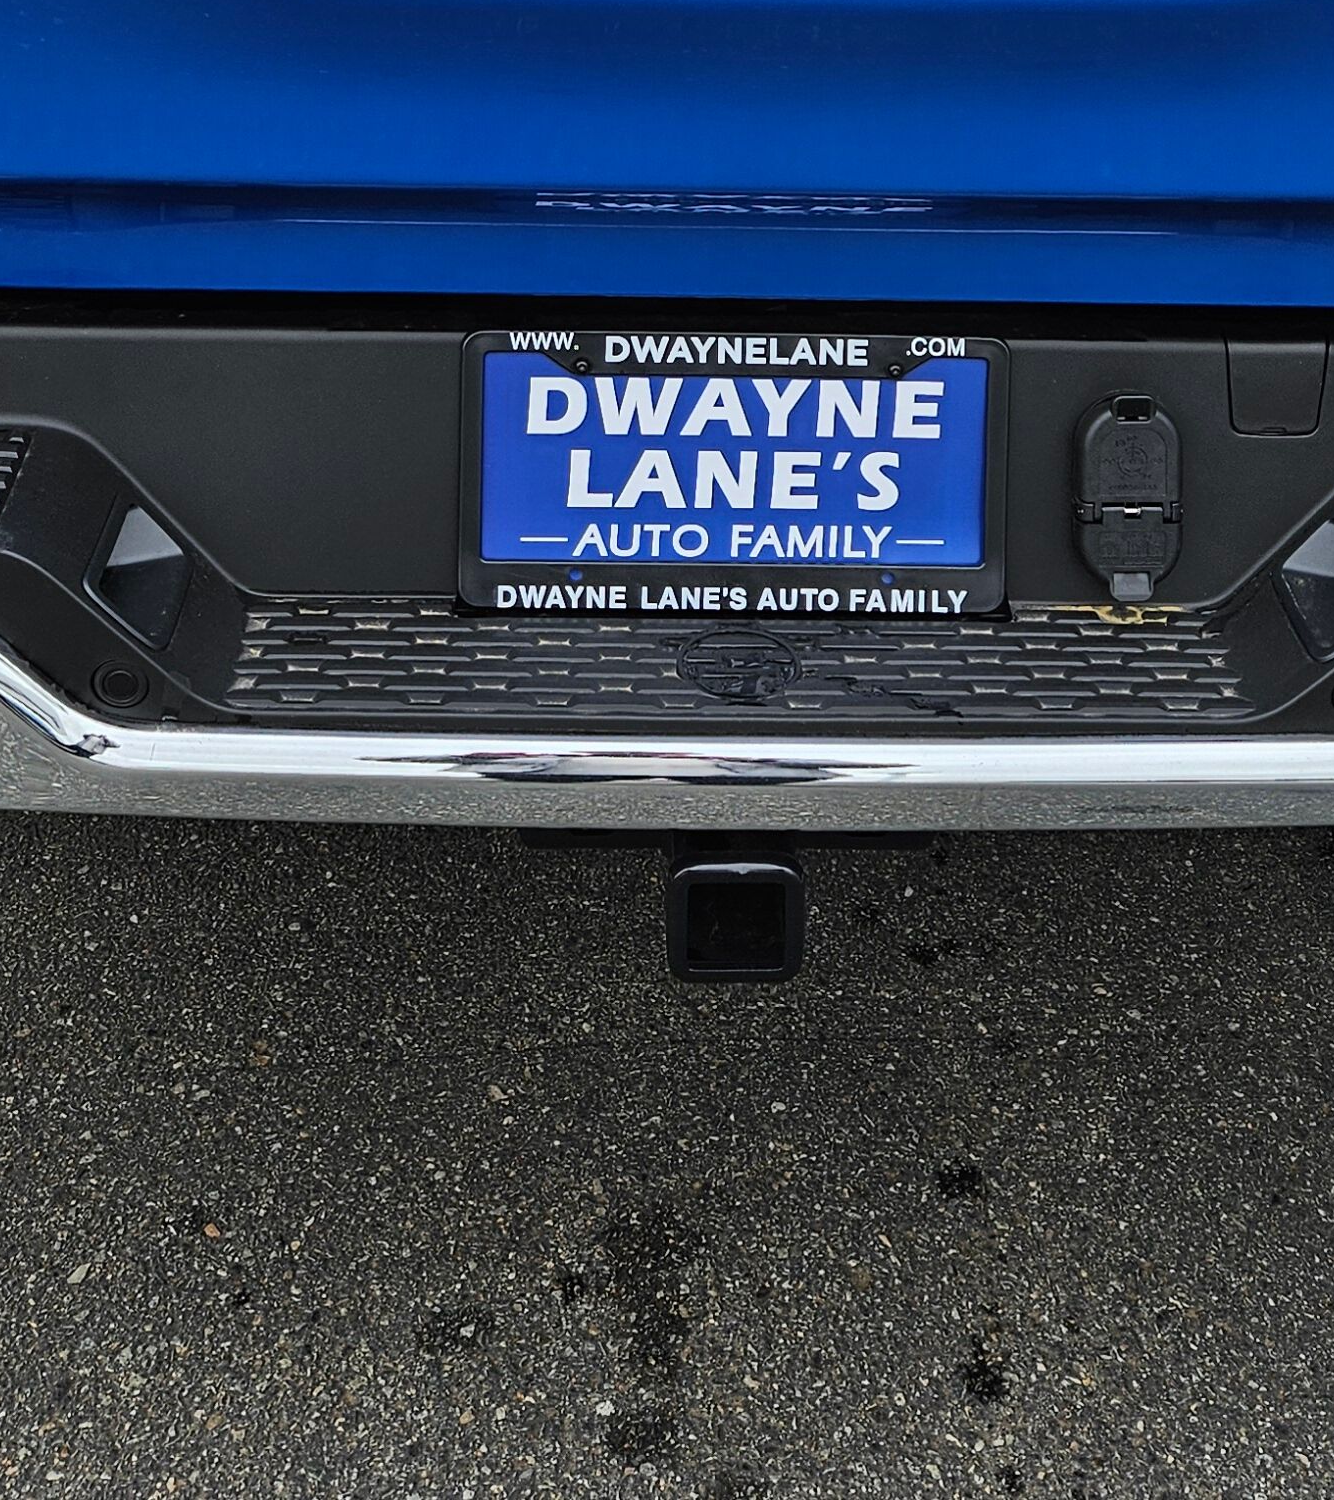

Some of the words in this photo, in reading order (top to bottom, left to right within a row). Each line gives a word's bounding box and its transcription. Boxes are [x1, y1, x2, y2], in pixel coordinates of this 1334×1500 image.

[509, 332, 580, 351] WWW.
[605, 335, 869, 368] DWAYNELANE
[905, 337, 966, 357] .COM
[526, 376, 945, 439] DWAYNE
[567, 449, 900, 512] LANE'S
[572, 524, 710, 558] AUTO
[730, 525, 893, 560] FAMILY
[496, 584, 627, 610] DWAYNE
[640, 586, 747, 611] LANE'S
[756, 587, 840, 612] AUTO
[848, 588, 968, 614] FAMILY
